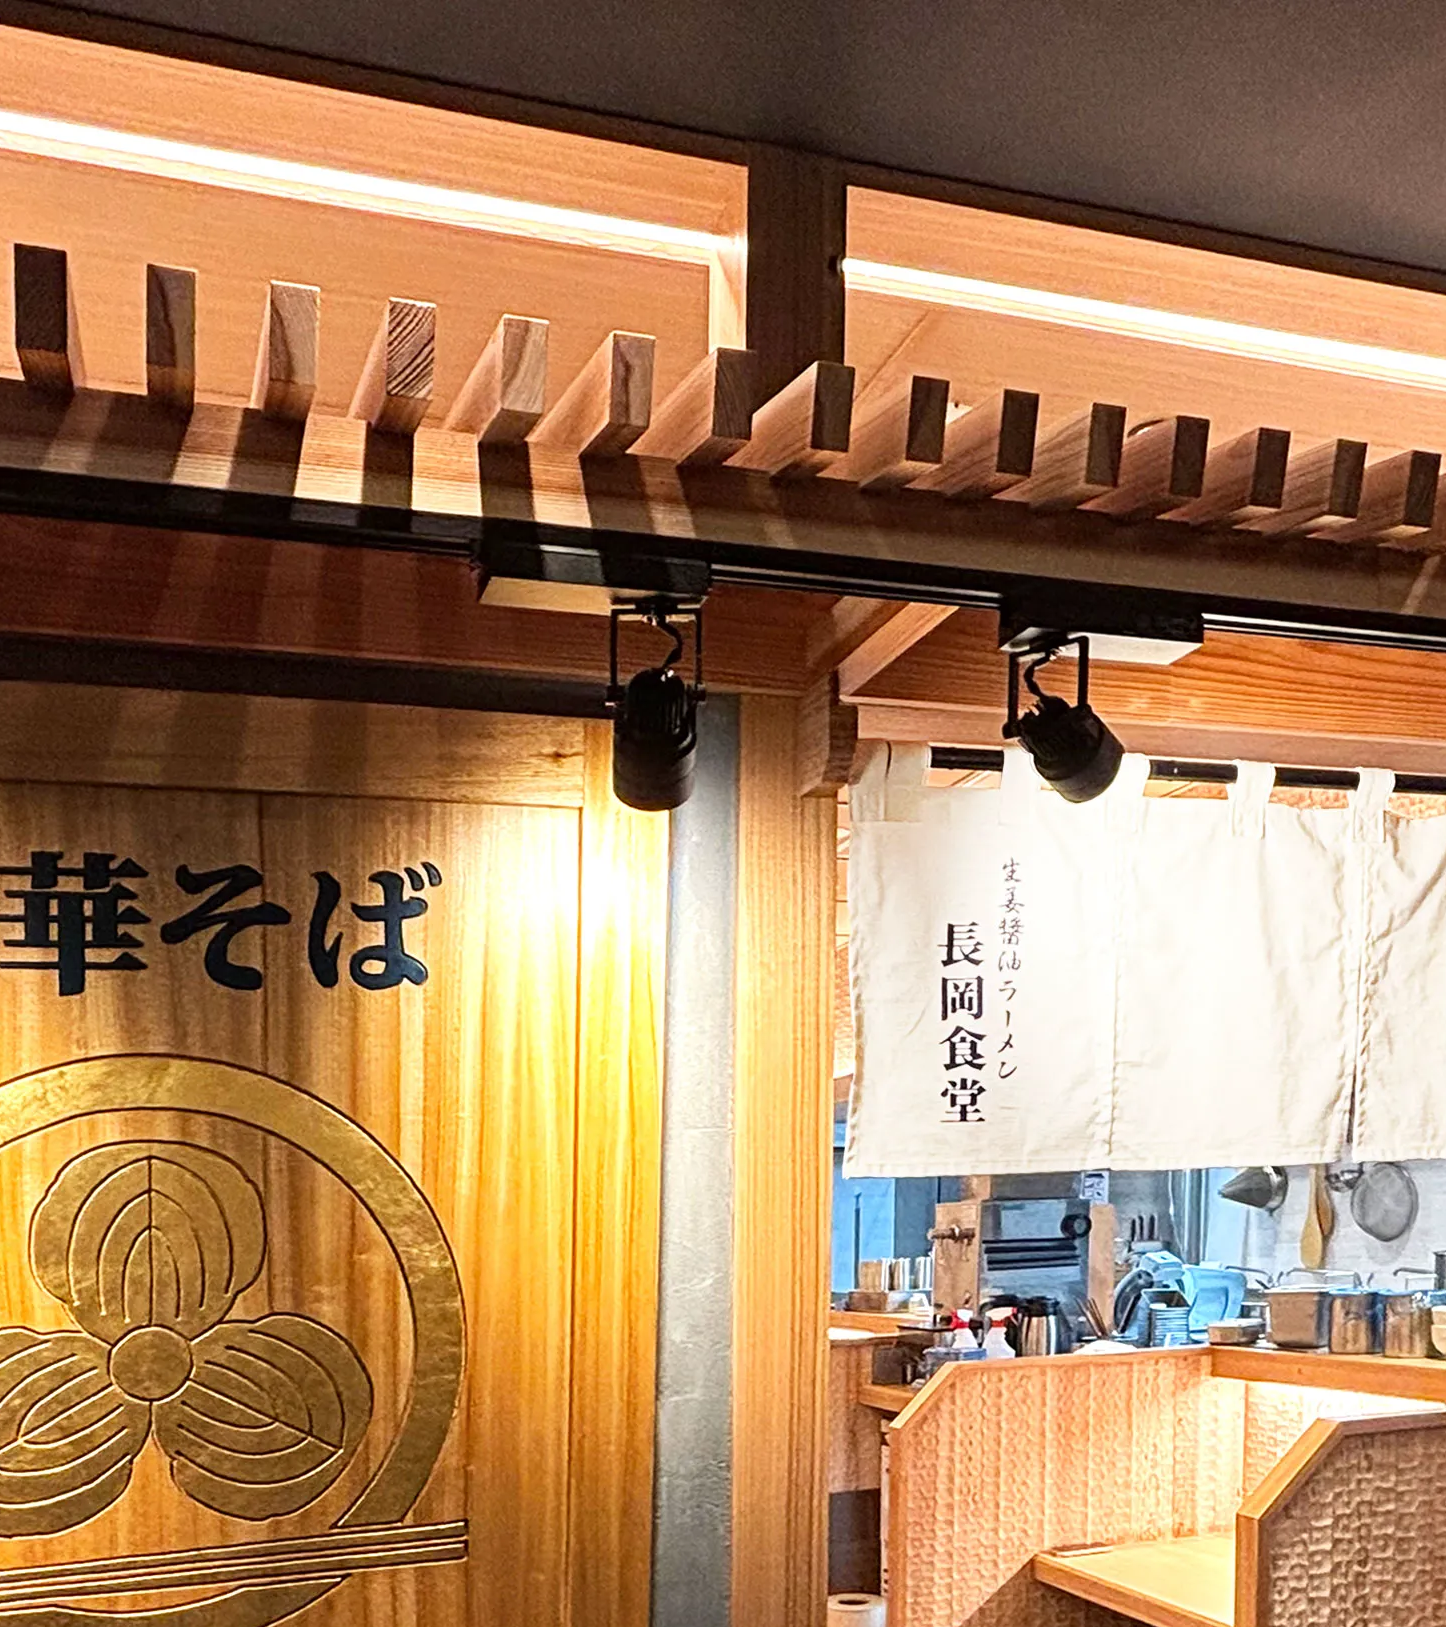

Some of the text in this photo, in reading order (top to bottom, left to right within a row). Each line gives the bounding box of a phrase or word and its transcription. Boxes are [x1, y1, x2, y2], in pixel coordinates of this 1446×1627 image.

[937, 922, 987, 1123] 長岡食堂
[998, 857, 1024, 1079] 生姜醤油ラーメン
